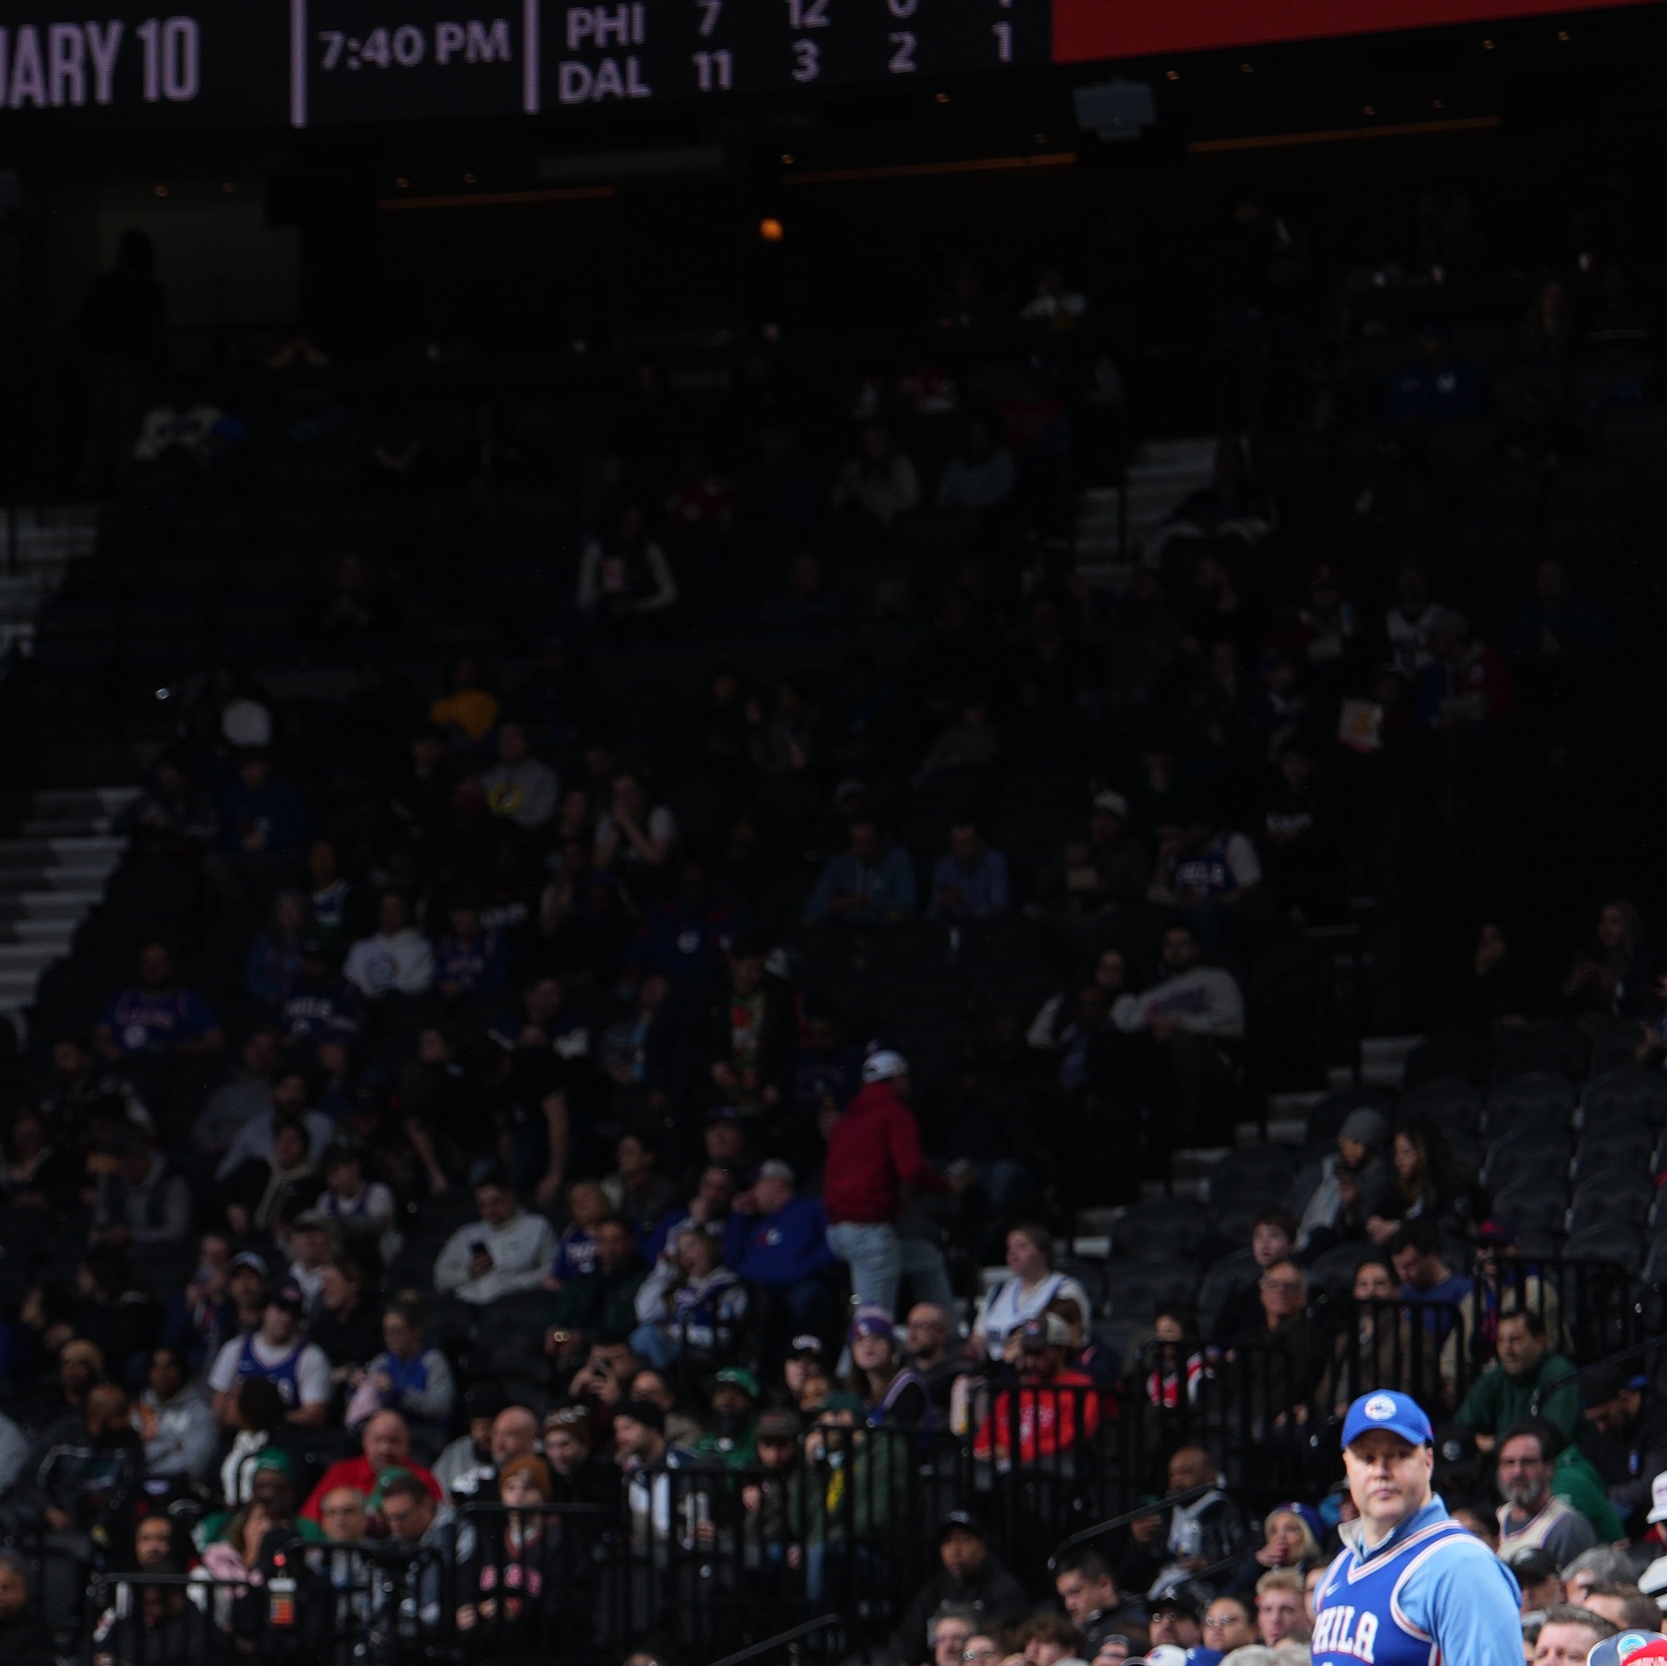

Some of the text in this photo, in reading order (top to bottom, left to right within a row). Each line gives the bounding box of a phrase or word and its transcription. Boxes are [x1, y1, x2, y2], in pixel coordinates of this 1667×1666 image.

[319, 20, 512, 70] 7:40 PM
[566, 2, 647, 51] PHI
[696, 0, 723, 38] 7
[137, 15, 199, 105] 10
[558, 20, 1014, 105] DAL 11 3 2 1
